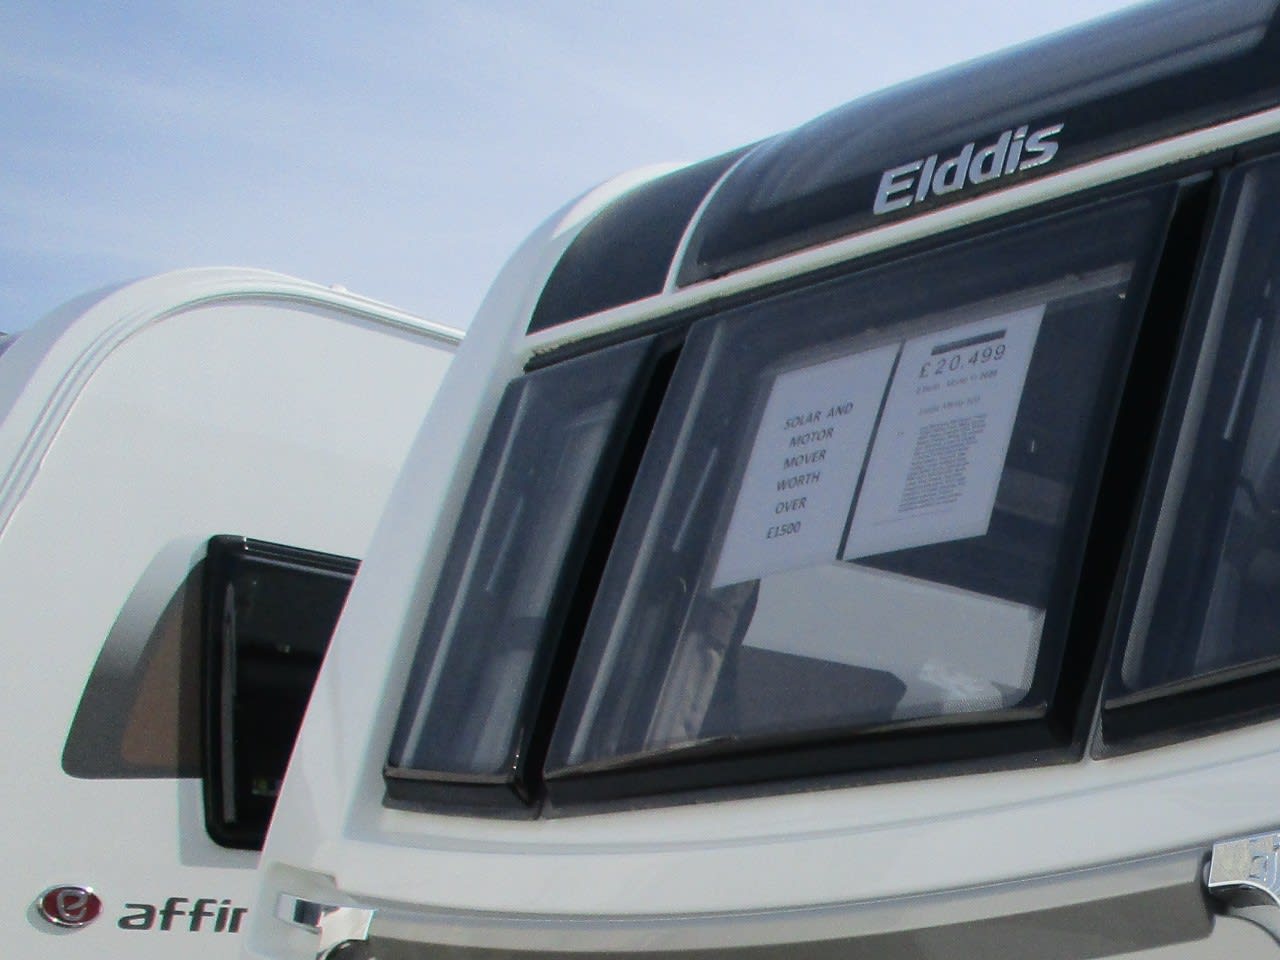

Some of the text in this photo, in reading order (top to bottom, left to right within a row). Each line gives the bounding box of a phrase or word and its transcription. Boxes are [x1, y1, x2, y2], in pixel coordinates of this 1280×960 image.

[872, 122, 1065, 216] Elddis
[783, 402, 854, 430] SOLAR AND
[789, 427, 835, 448] MOTOR
[783, 449, 827, 470] MOVER
[776, 471, 821, 491] WORTH
[775, 496, 808, 515] OVER
